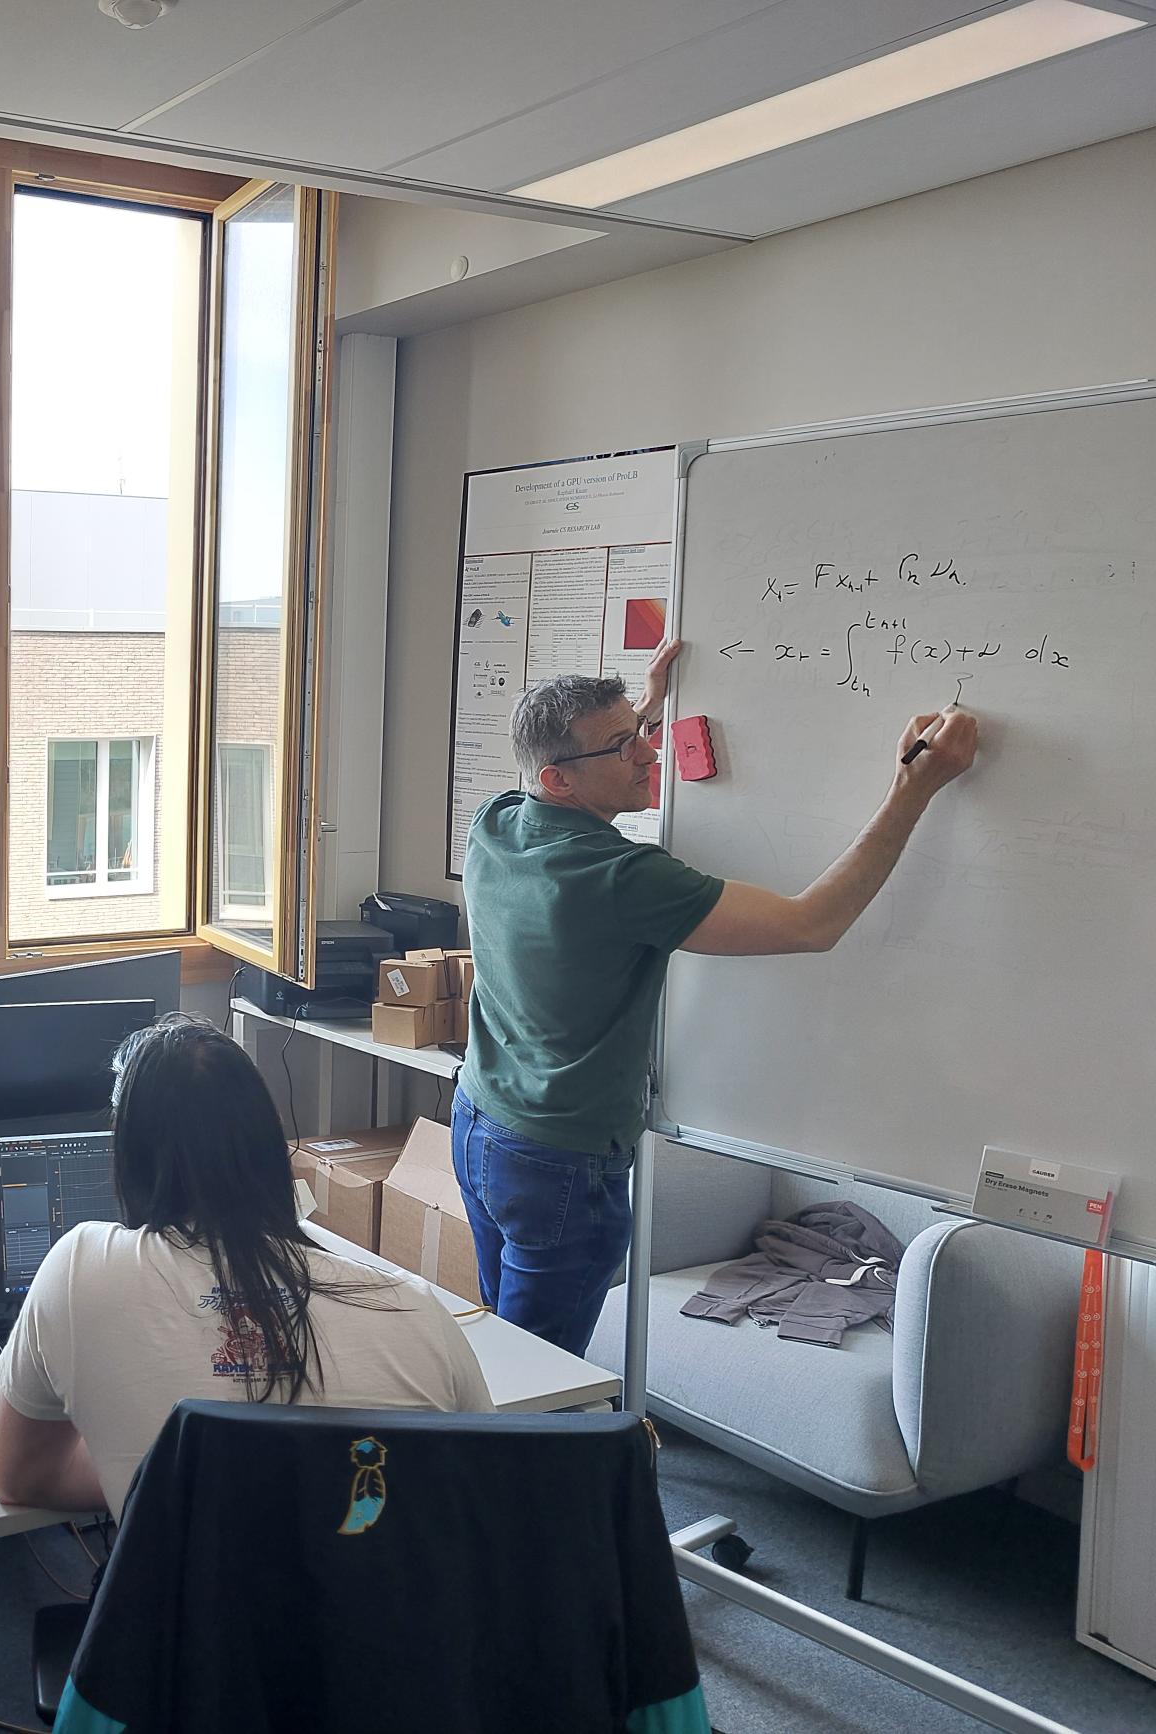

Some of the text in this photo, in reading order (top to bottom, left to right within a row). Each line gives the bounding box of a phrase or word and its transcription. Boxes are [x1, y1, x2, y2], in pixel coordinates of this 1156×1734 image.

[515, 480, 552, 493] Development
[554, 479, 561, 488] of
[566, 477, 582, 487] GPU
[583, 475, 607, 485] version
[608, 473, 615, 482] of
[616, 470, 638, 481] ProLB
[590, 523, 601, 531] LAB
[985, 1177, 997, 1187] Dry
[998, 1180, 1018, 1191] Erase
[1018, 1184, 1049, 1198] Magnets
